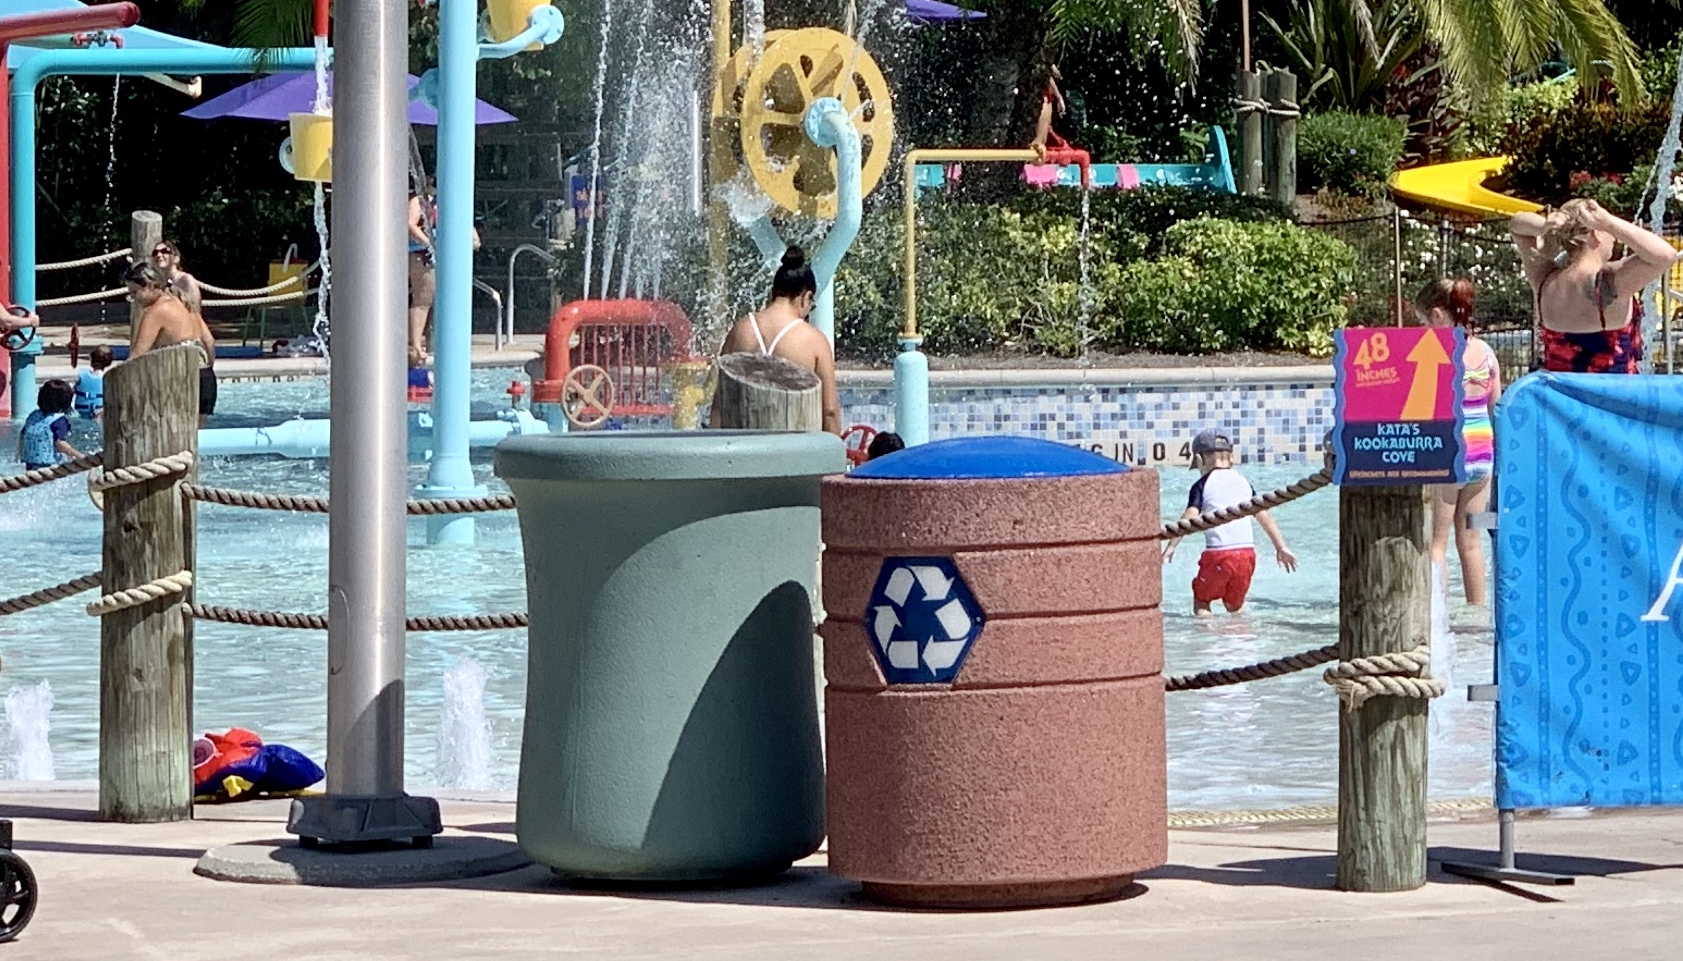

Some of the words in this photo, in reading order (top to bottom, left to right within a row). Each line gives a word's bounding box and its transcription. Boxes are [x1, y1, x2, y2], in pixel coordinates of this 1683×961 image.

[1353, 332, 1390, 369] 48
[1355, 367, 1397, 382] INCHES
[1377, 423, 1420, 436] KATA'S
[1354, 436, 1443, 451] KOOKABURRA
[1382, 451, 1416, 463] COVE
